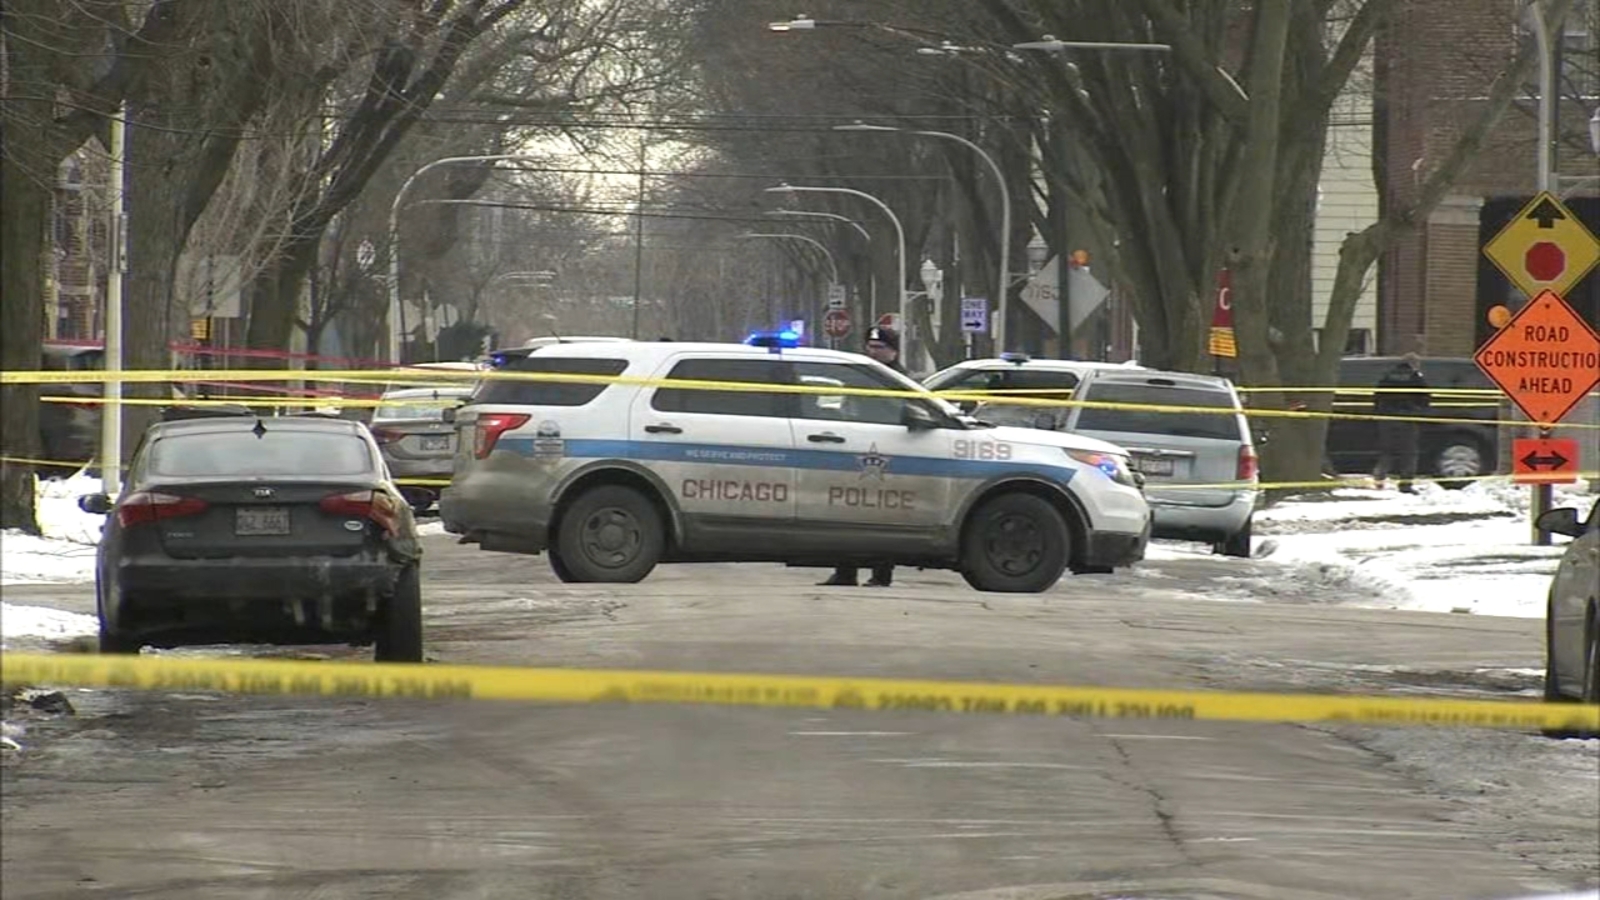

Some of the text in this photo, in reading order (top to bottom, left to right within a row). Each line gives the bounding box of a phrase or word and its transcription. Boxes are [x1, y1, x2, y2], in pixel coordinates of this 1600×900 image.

[1525, 325, 1569, 342] ROAD
[1484, 350, 1600, 369] CONSTRUCTIO
[1520, 377, 1572, 394] AHEAD
[954, 439, 1012, 460] 9169
[682, 479, 789, 503] CHICAGO
[828, 486, 918, 510] POLICE
